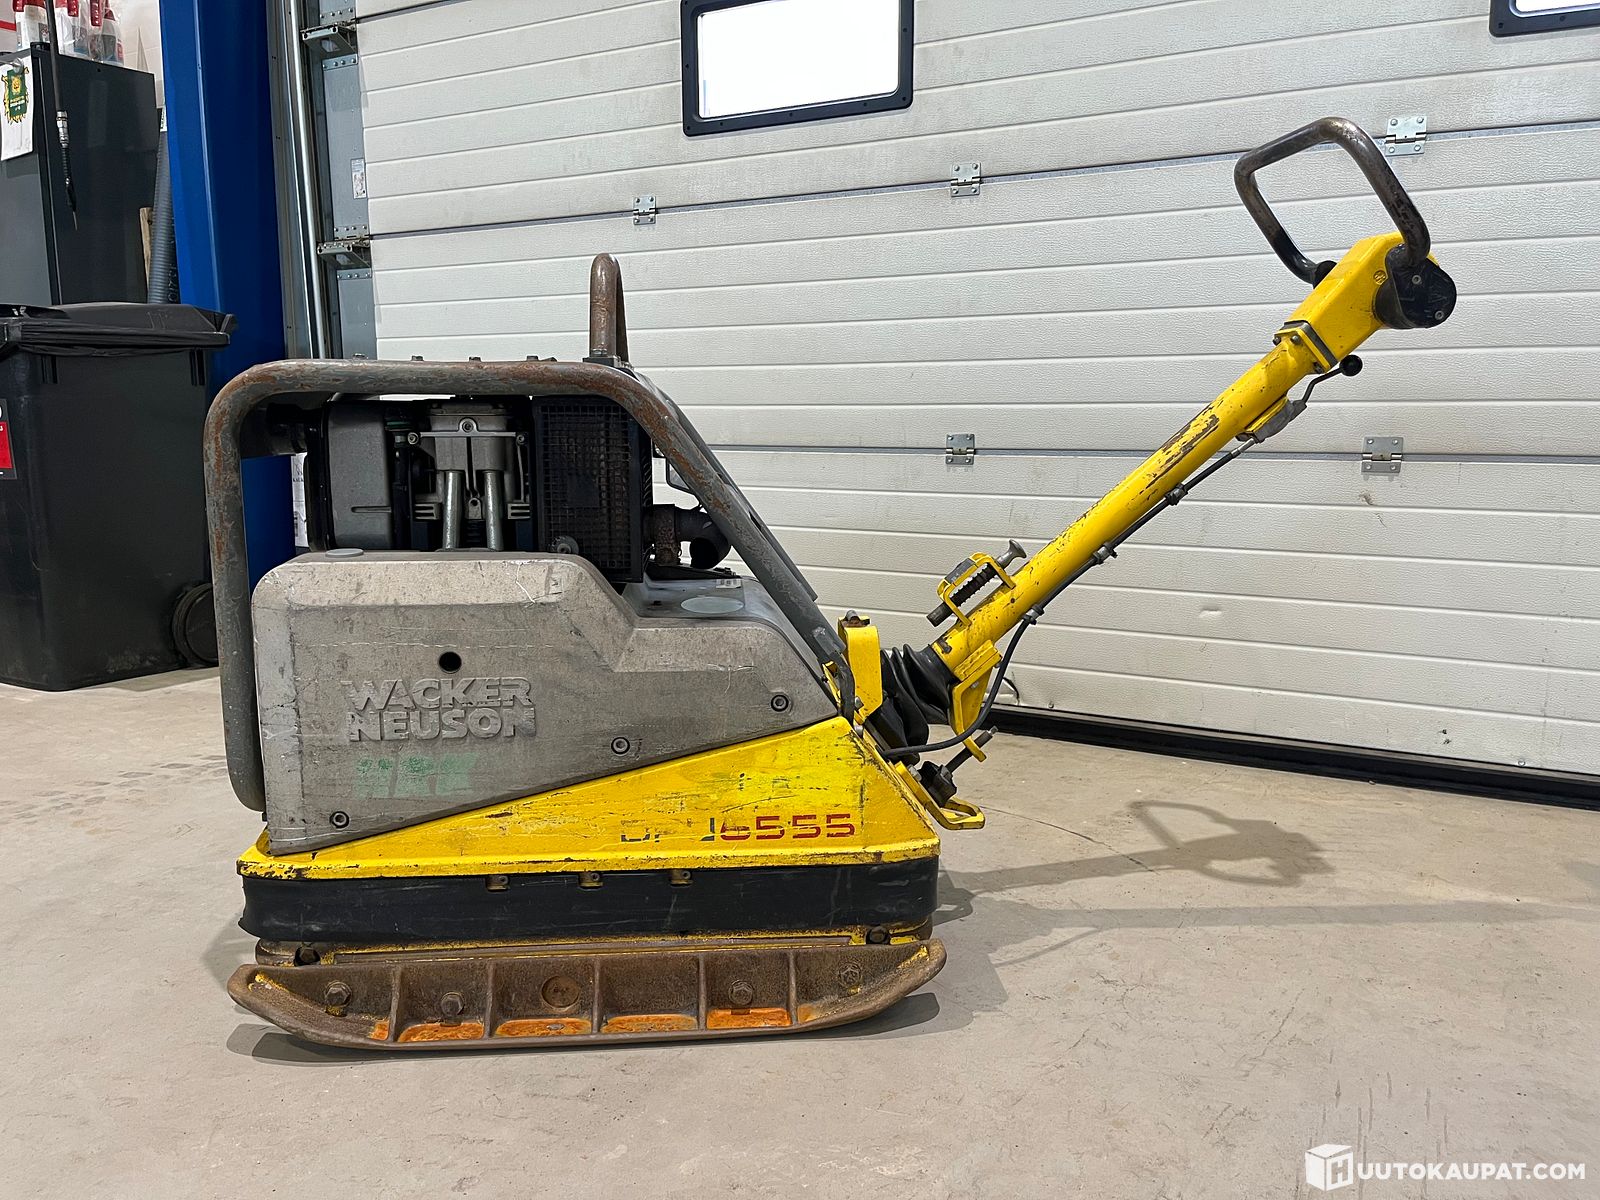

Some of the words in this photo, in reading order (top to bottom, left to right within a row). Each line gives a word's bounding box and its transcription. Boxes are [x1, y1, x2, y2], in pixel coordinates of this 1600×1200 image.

[341, 677, 534, 709] WACKER
[347, 708, 536, 742] NEUSON
[621, 813, 856, 843] 6555
